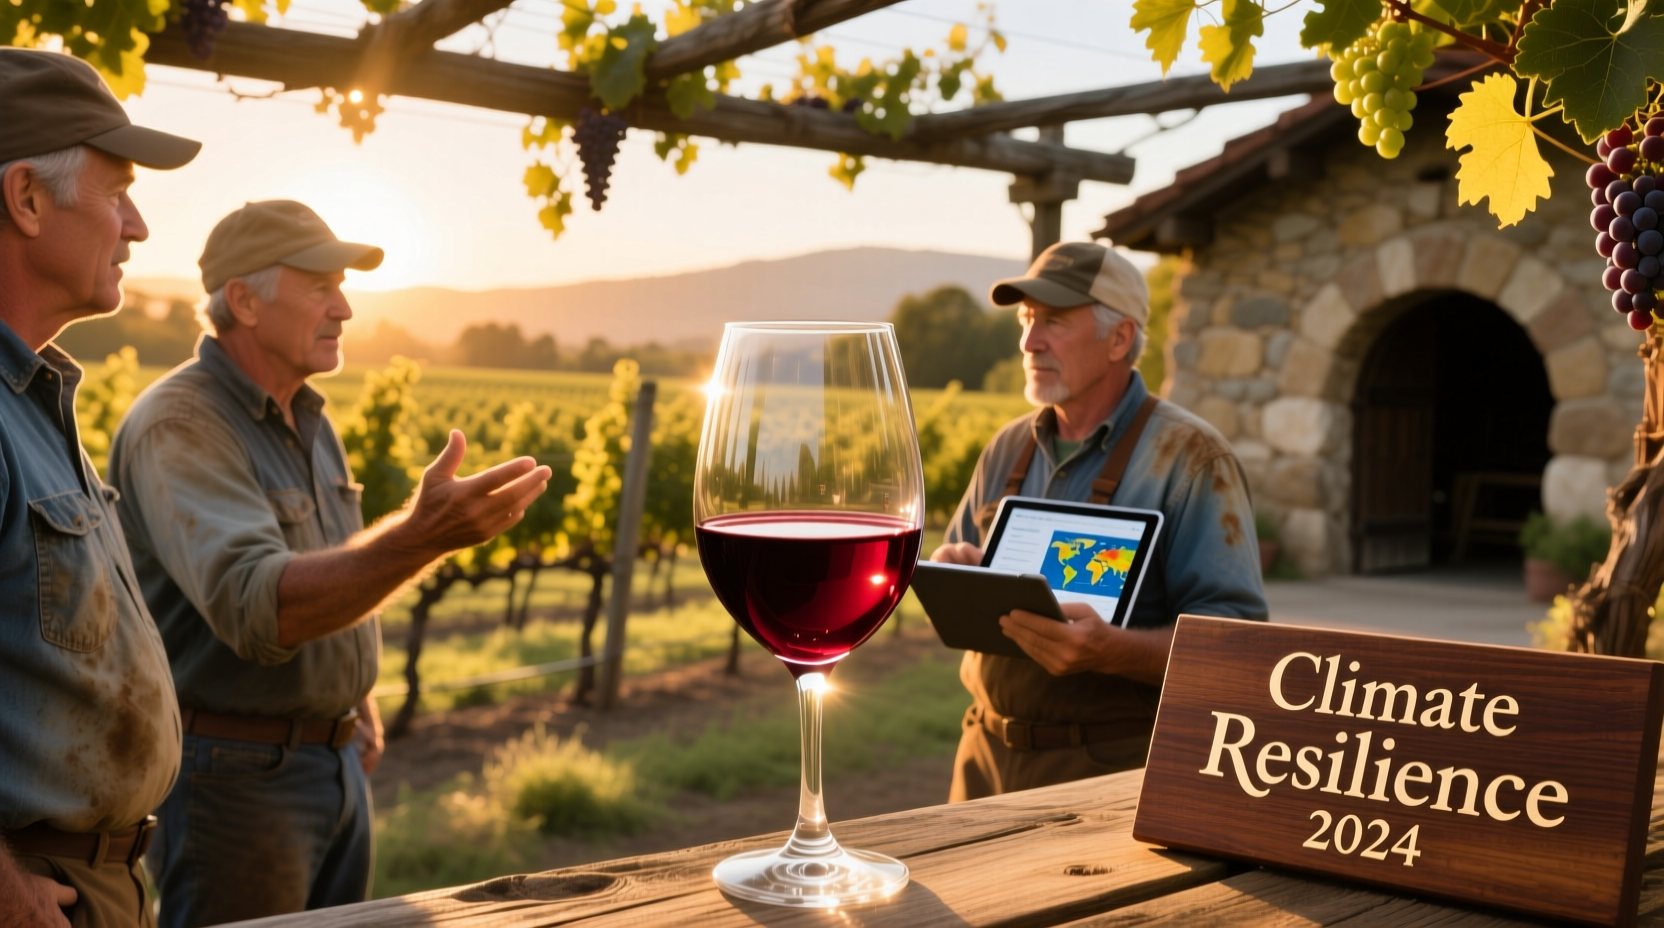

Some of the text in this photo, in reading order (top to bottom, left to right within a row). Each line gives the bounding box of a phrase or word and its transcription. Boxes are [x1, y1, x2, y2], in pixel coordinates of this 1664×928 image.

[1269, 651, 1519, 737] Climate
[1199, 711, 1569, 829] Resilience
[1303, 809, 1421, 867] 2024
